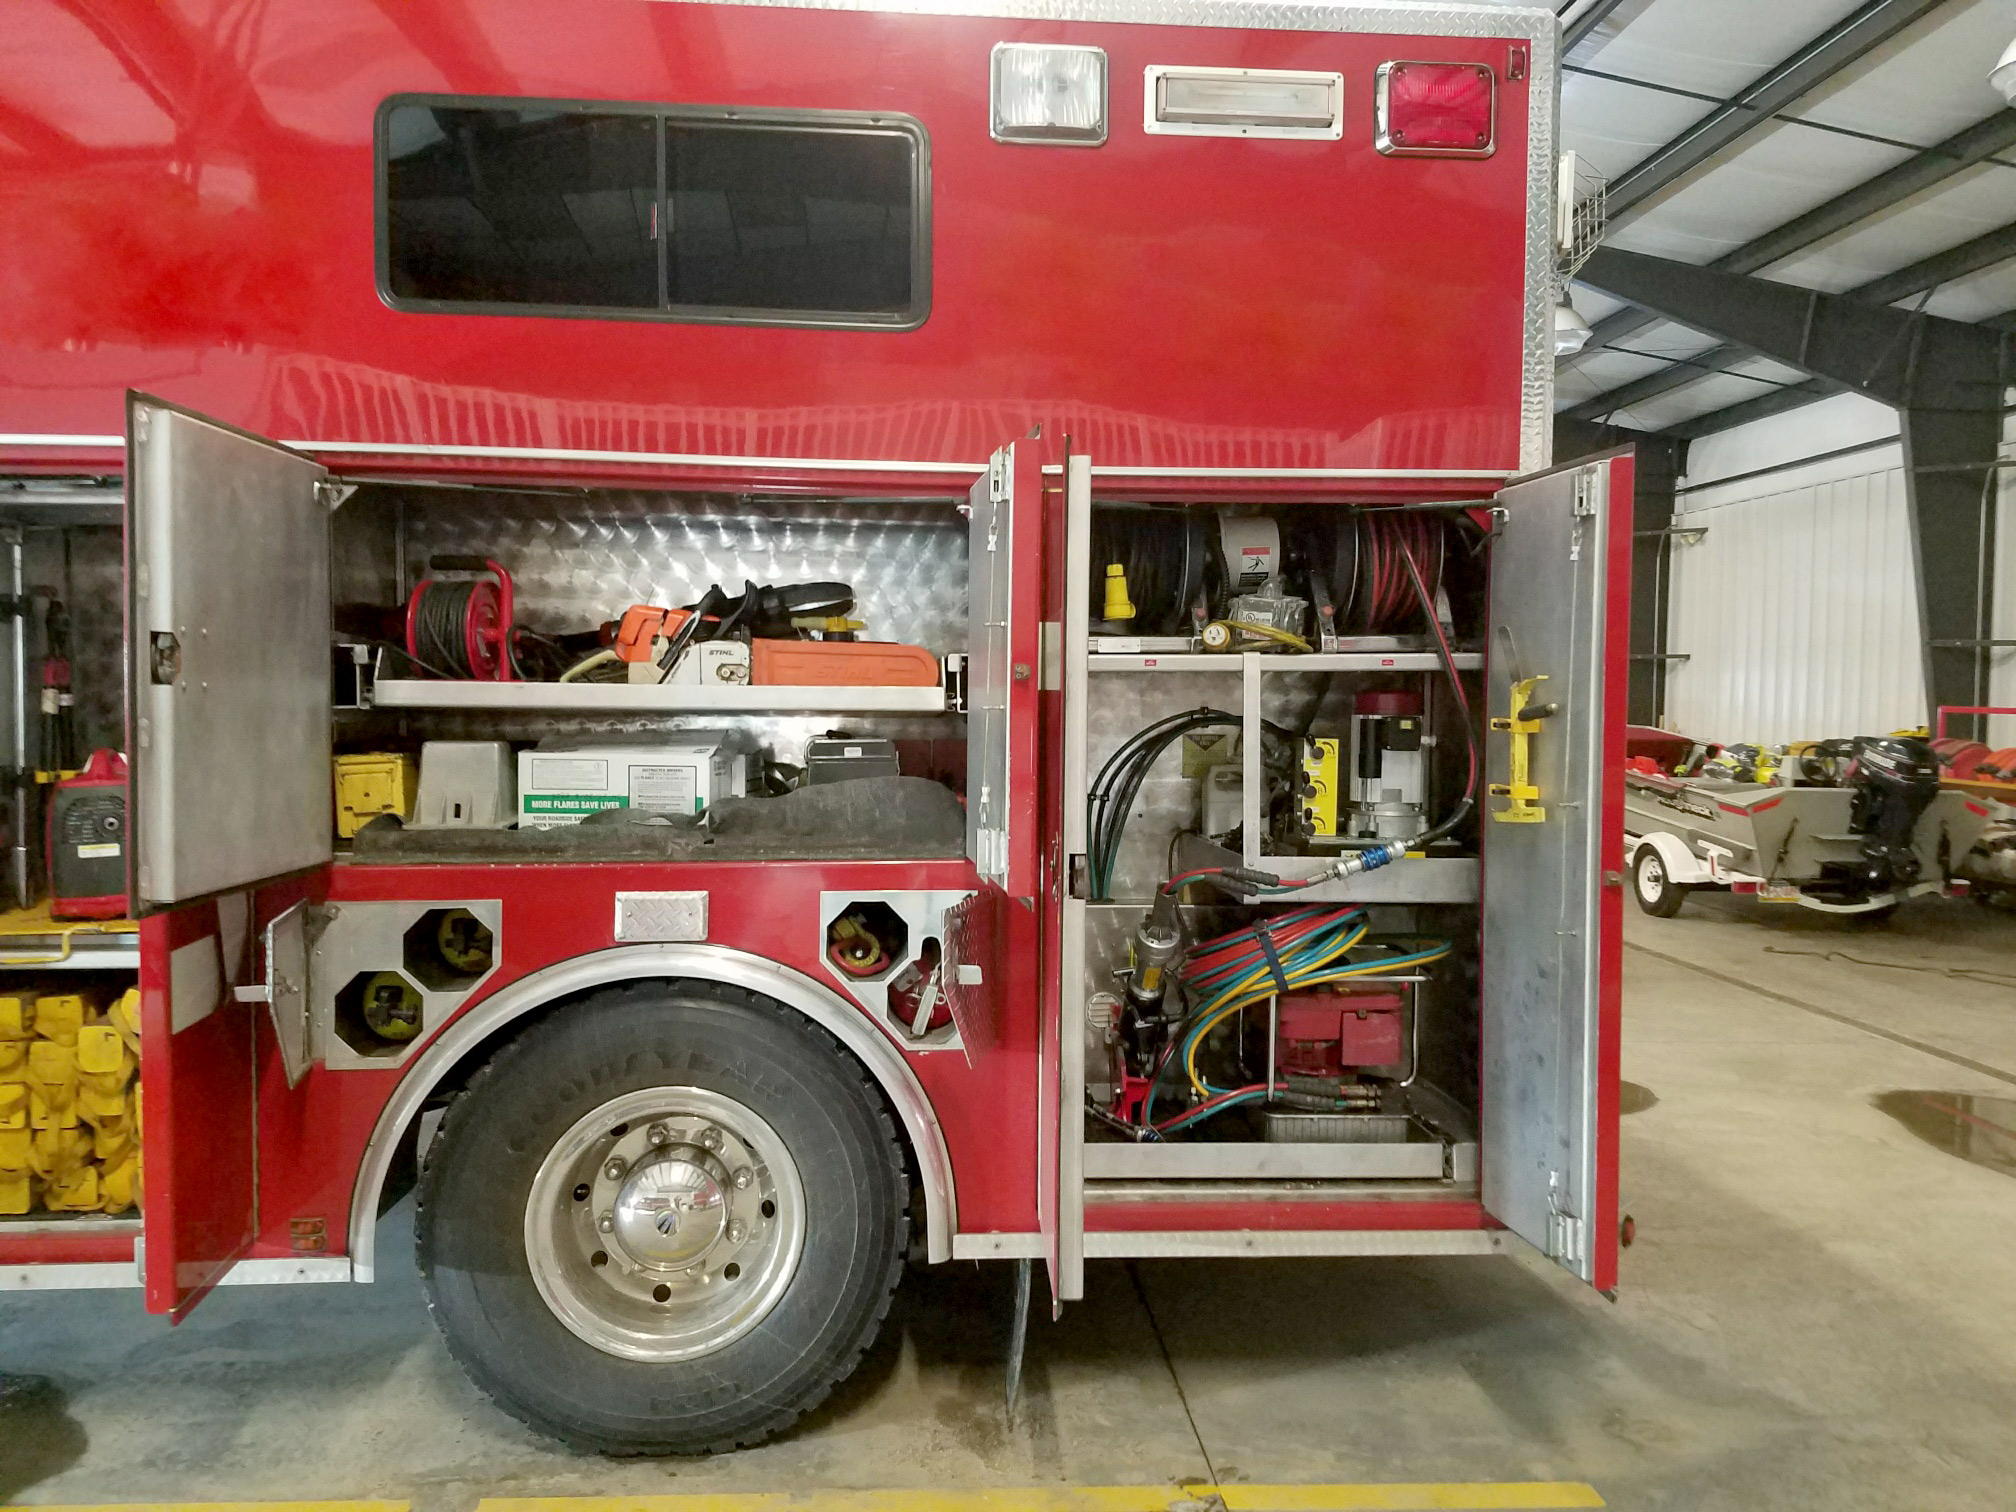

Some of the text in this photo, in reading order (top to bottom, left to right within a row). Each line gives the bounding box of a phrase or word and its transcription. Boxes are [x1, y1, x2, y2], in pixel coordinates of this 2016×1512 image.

[531, 800, 620, 809] MORE FLARES SAVE LIVES
